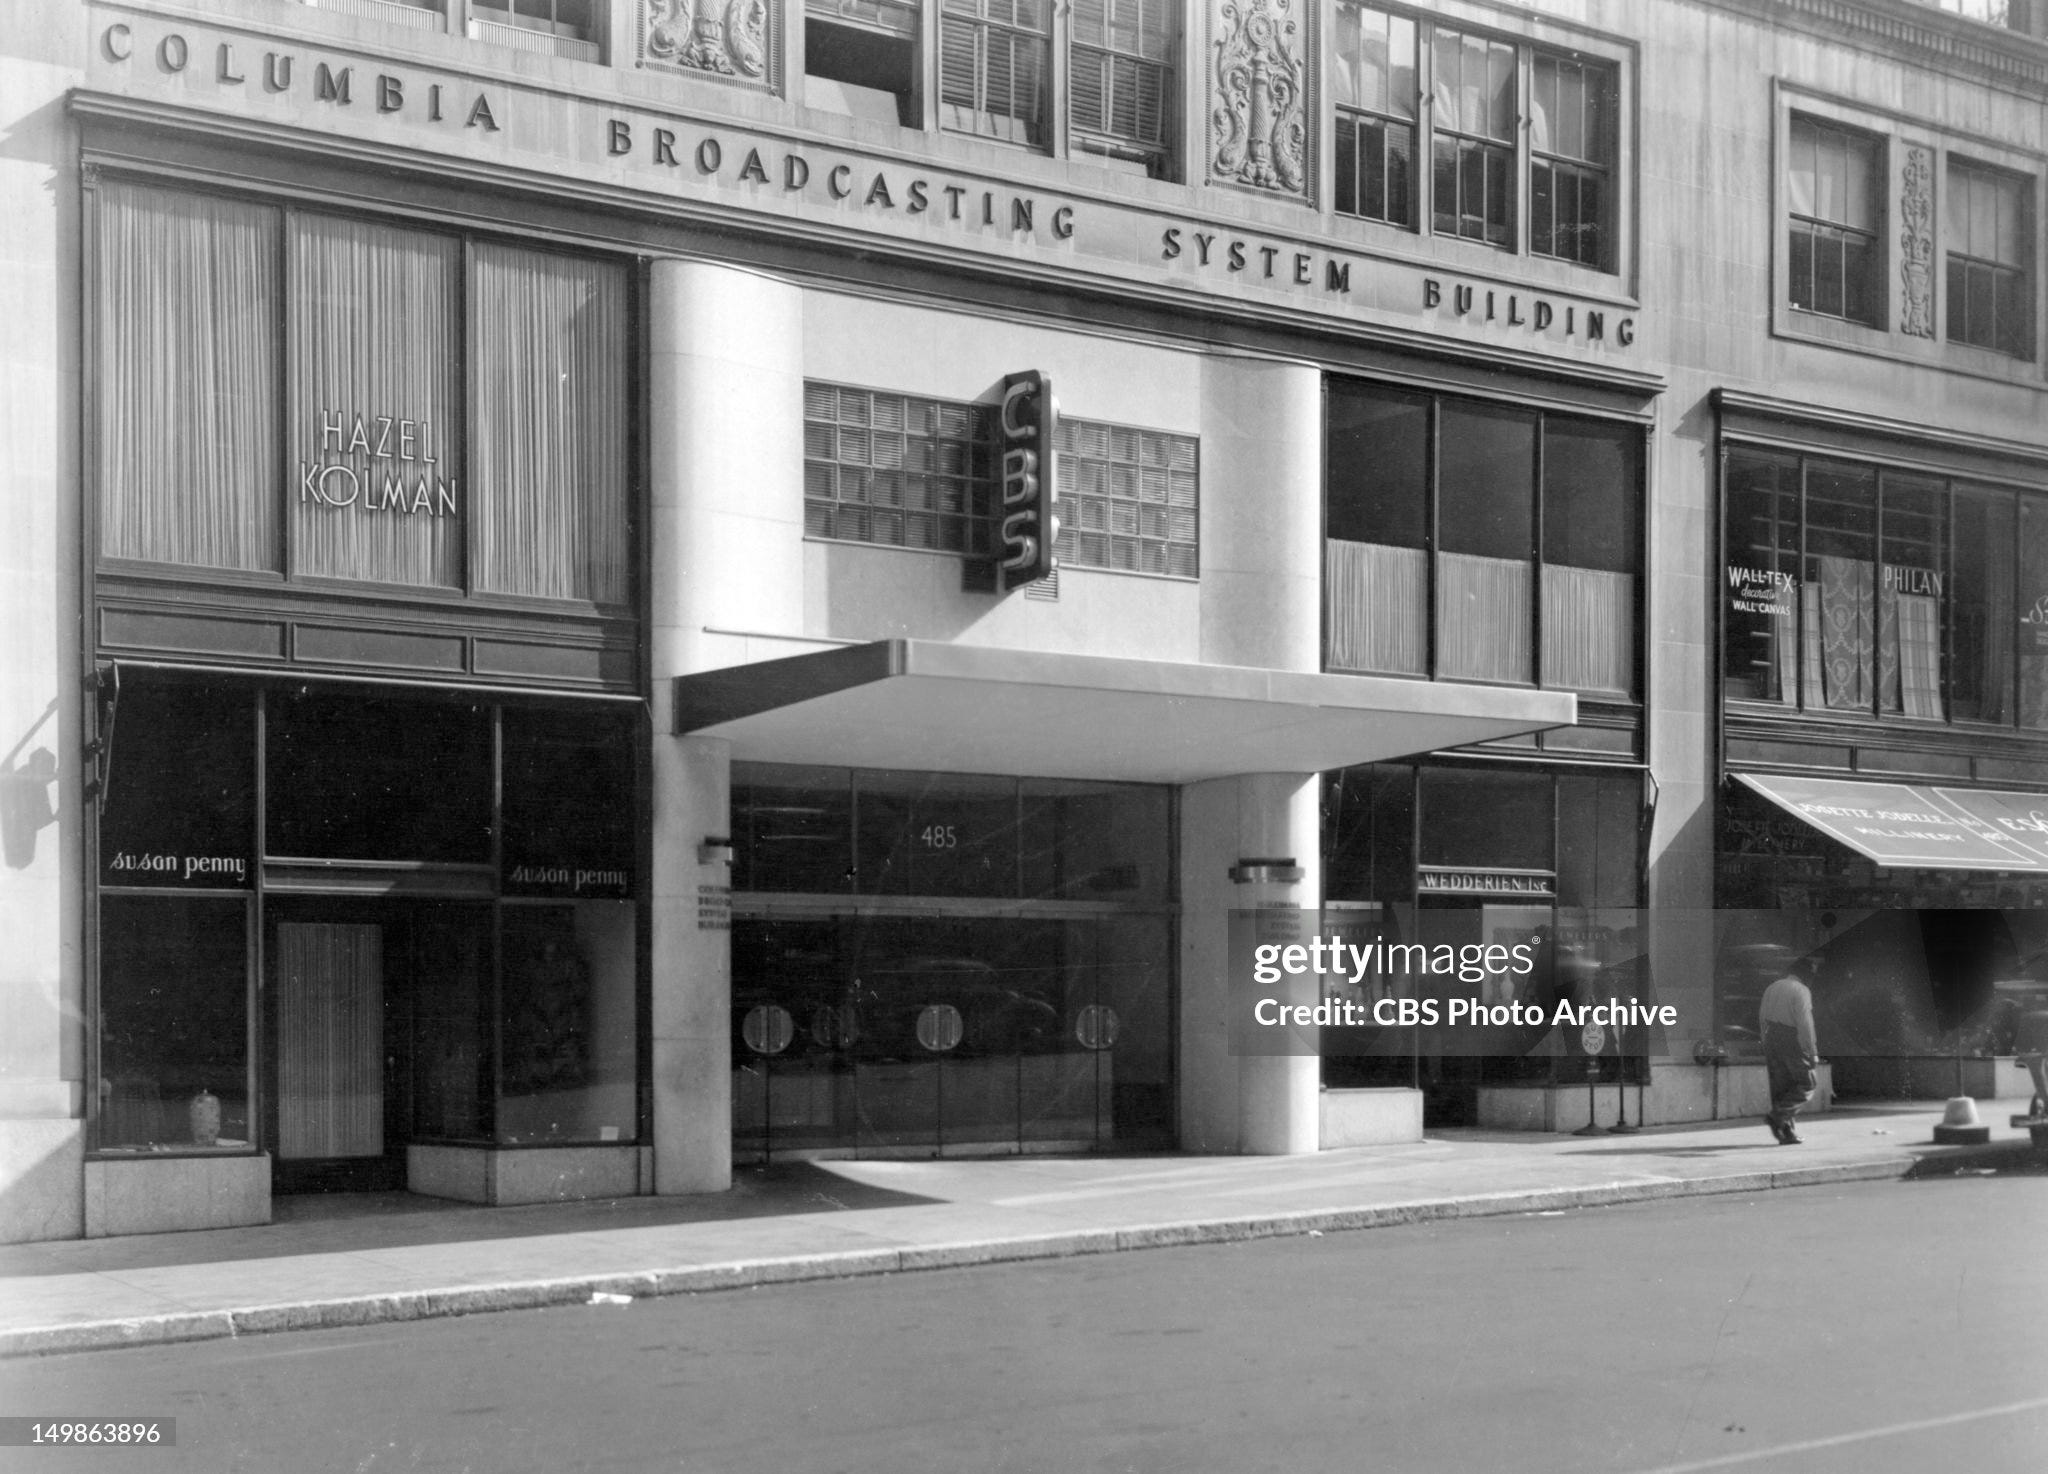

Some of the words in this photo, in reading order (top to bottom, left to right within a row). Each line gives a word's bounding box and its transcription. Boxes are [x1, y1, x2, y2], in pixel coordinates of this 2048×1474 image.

[101, 23, 500, 131] COLUMBIA
[607, 118, 1076, 239] BROADCASTING
[1162, 227, 1352, 295] SYSTEM
[1424, 277, 1635, 347] BUILDING
[322, 408, 437, 464] HAZEL
[300, 460, 458, 518] KOLMAN
[1001, 379, 1039, 569] CBS
[1732, 599, 1756, 613] WALL
[1758, 602, 1791, 616] CANVAS
[921, 825, 957, 848] 485
[109, 852, 177, 871] susan
[184, 855, 246, 881] penny
[511, 865, 569, 882] susan
[575, 868, 627, 895] penny
[1425, 873, 1521, 891] WEDDERIEN
